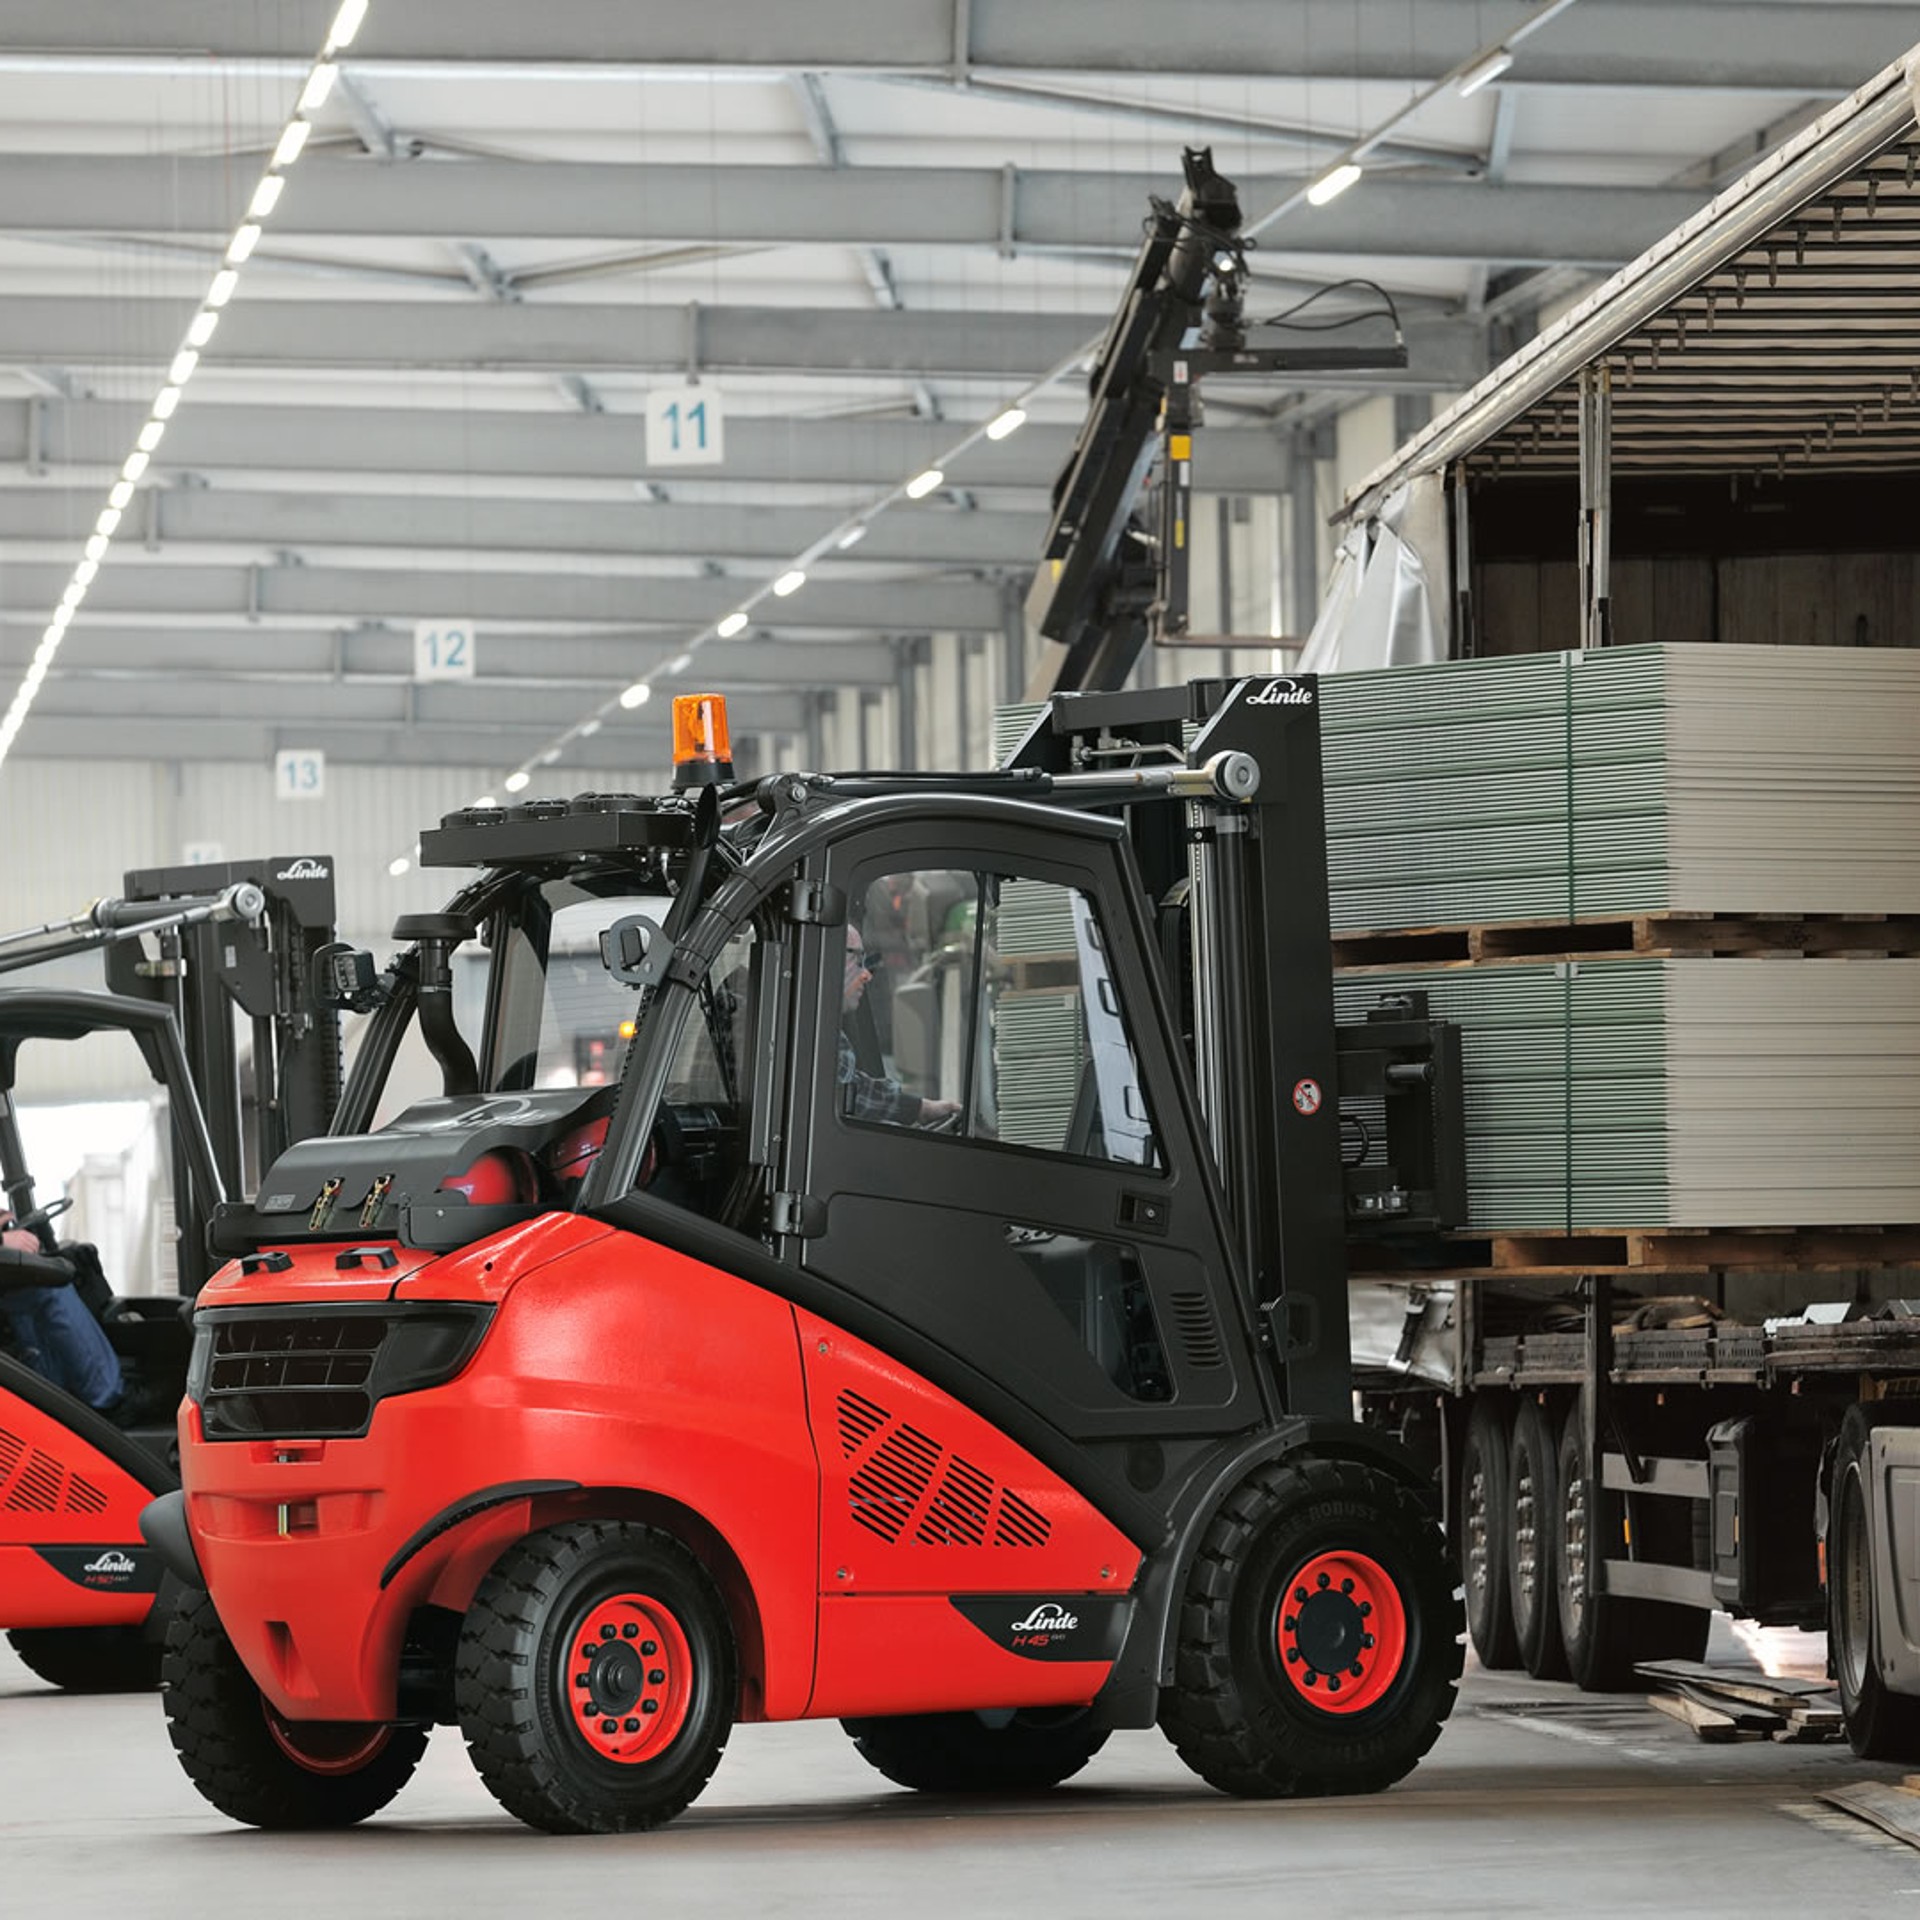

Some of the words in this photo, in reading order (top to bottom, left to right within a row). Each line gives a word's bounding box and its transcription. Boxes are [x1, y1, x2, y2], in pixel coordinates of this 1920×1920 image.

[661, 400, 705, 449] 11
[423, 630, 466, 668] 12
[1246, 678, 1313, 704] Linde
[284, 758, 319, 789] 13
[277, 858, 329, 880] Linde
[84, 1551, 136, 1572] Linde
[1011, 1603, 1078, 1631] Linde
